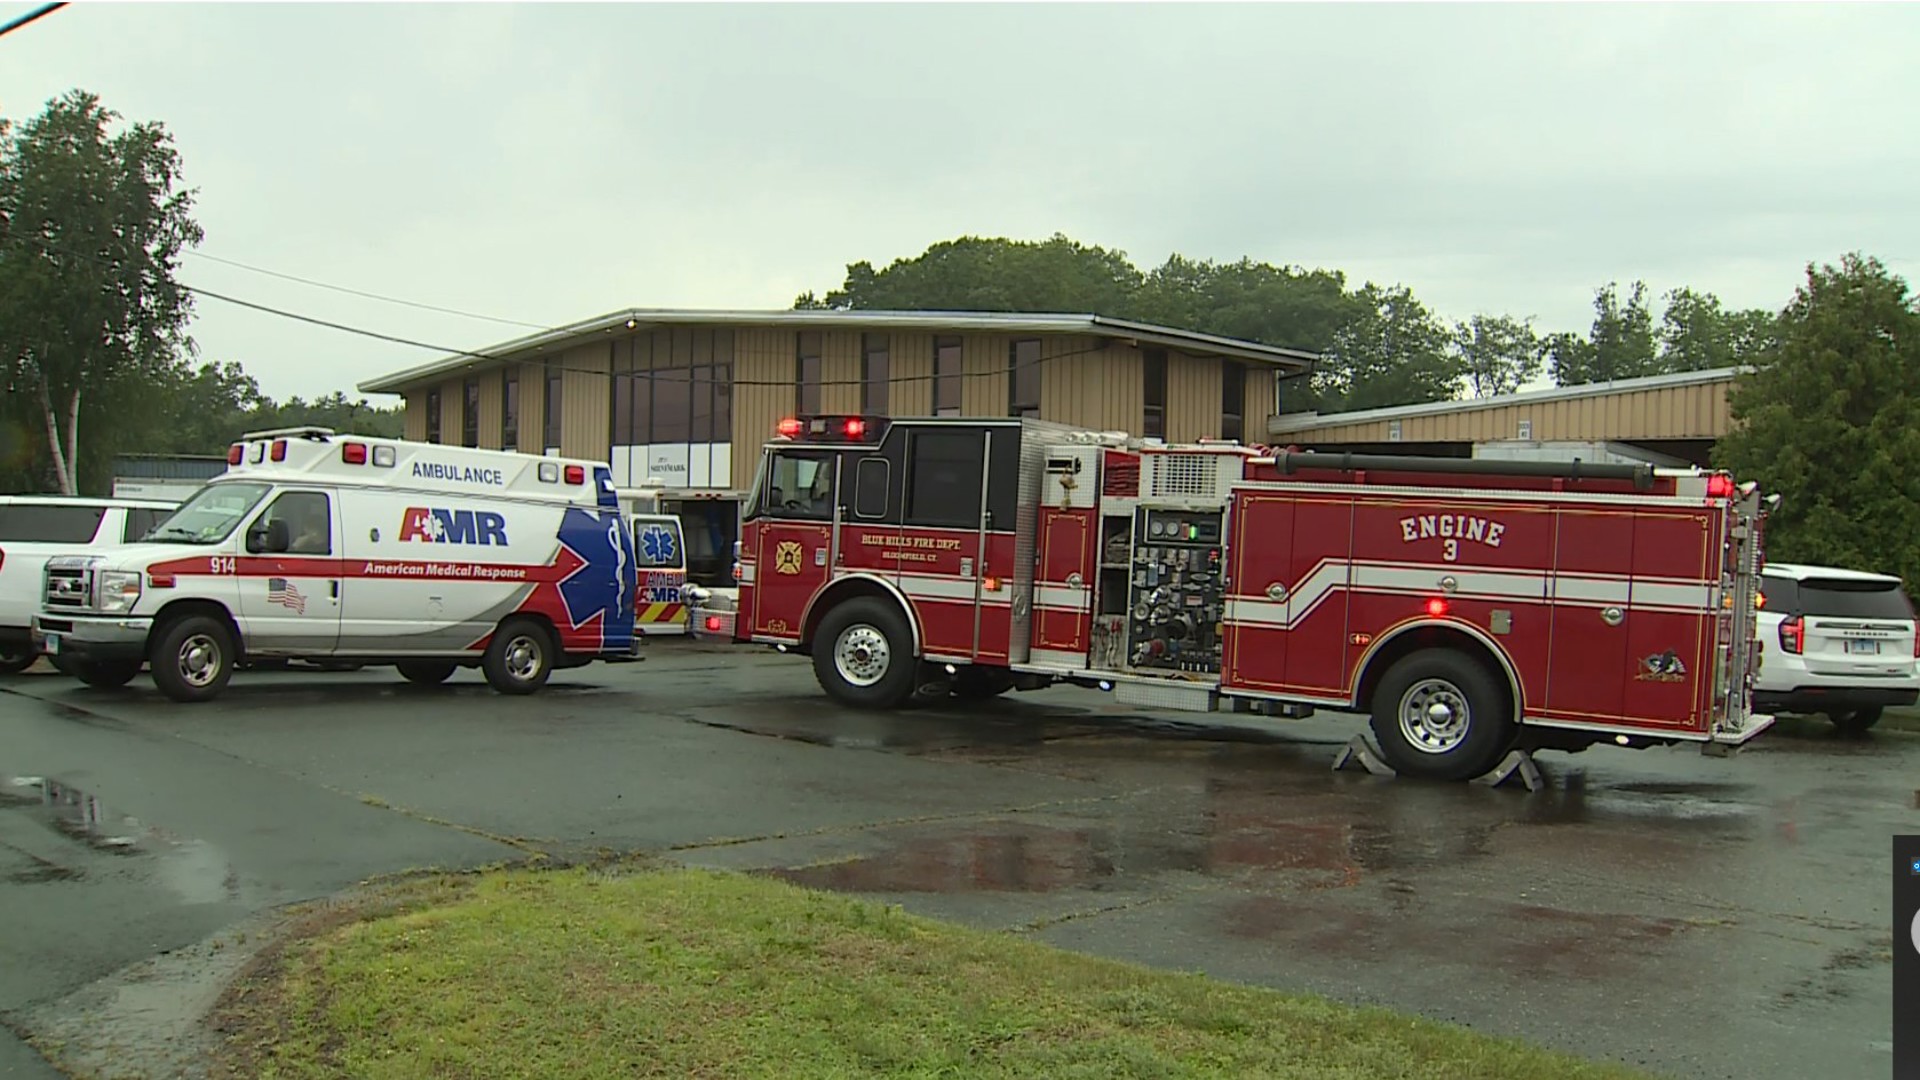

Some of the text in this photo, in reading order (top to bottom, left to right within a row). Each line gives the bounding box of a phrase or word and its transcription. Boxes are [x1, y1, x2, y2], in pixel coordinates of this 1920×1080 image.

[412, 461, 503, 485] AMBULANCE
[399, 507, 509, 547] AMR
[1400, 514, 1505, 547] ENGINE
[861, 533, 885, 546] BLUE
[885, 535, 912, 547] HILLS
[913, 537, 935, 549] FIRE
[1443, 539, 1457, 561] 3
[210, 556, 236, 574] 914
[363, 561, 526, 579] American Medical Response
[637, 587, 680, 603] AMR
